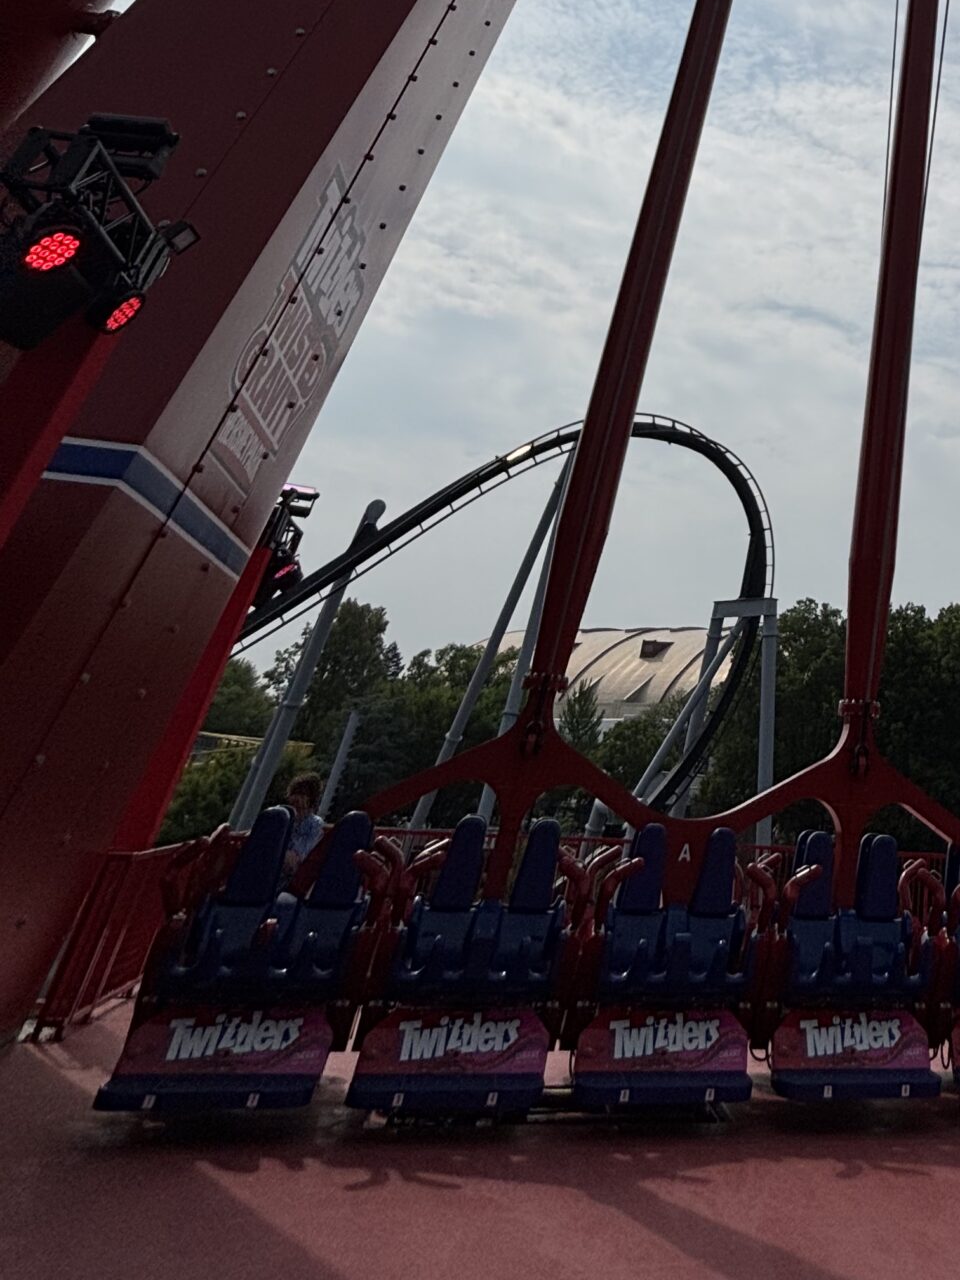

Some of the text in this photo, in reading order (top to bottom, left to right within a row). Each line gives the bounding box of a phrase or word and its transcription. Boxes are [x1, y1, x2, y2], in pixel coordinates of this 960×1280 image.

[677, 842, 692, 863] A
[165, 1011, 303, 1061] Twizzlers
[398, 1012, 520, 1061] Twizzlers
[609, 1012, 720, 1059] Twizzlers
[799, 1012, 901, 1058] Twizzlers
